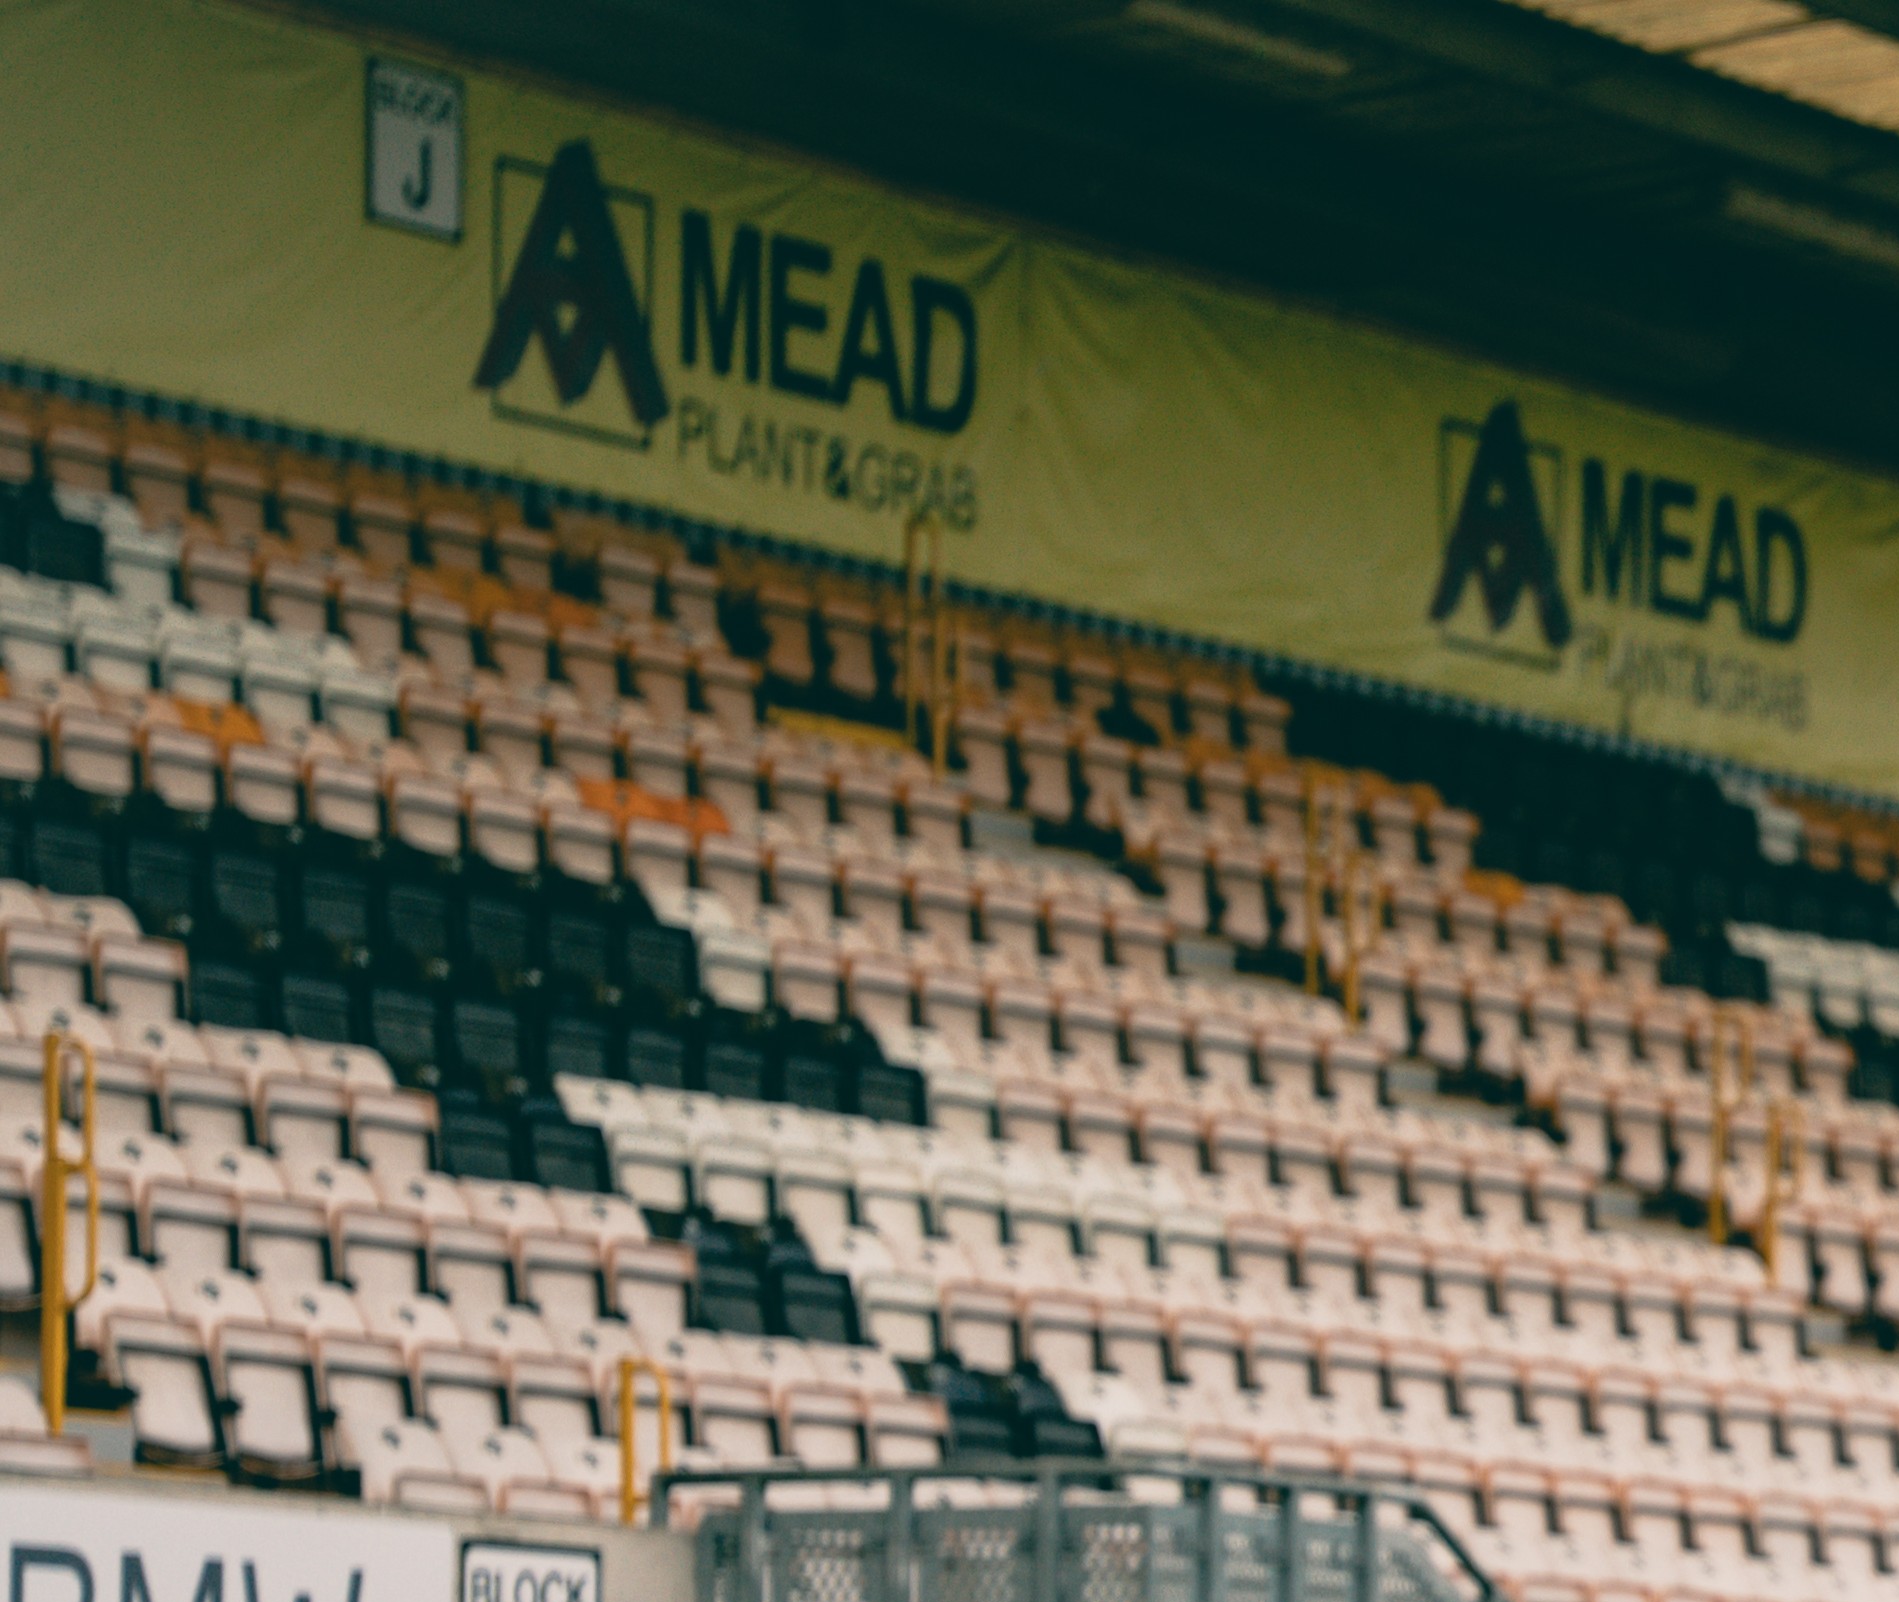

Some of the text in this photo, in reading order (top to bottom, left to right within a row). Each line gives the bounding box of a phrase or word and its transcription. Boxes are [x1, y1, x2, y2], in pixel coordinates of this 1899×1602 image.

[680, 205, 979, 437] MEAD
[677, 396, 979, 534] PLANT&GRAB
[1579, 455, 1811, 646] MEAD
